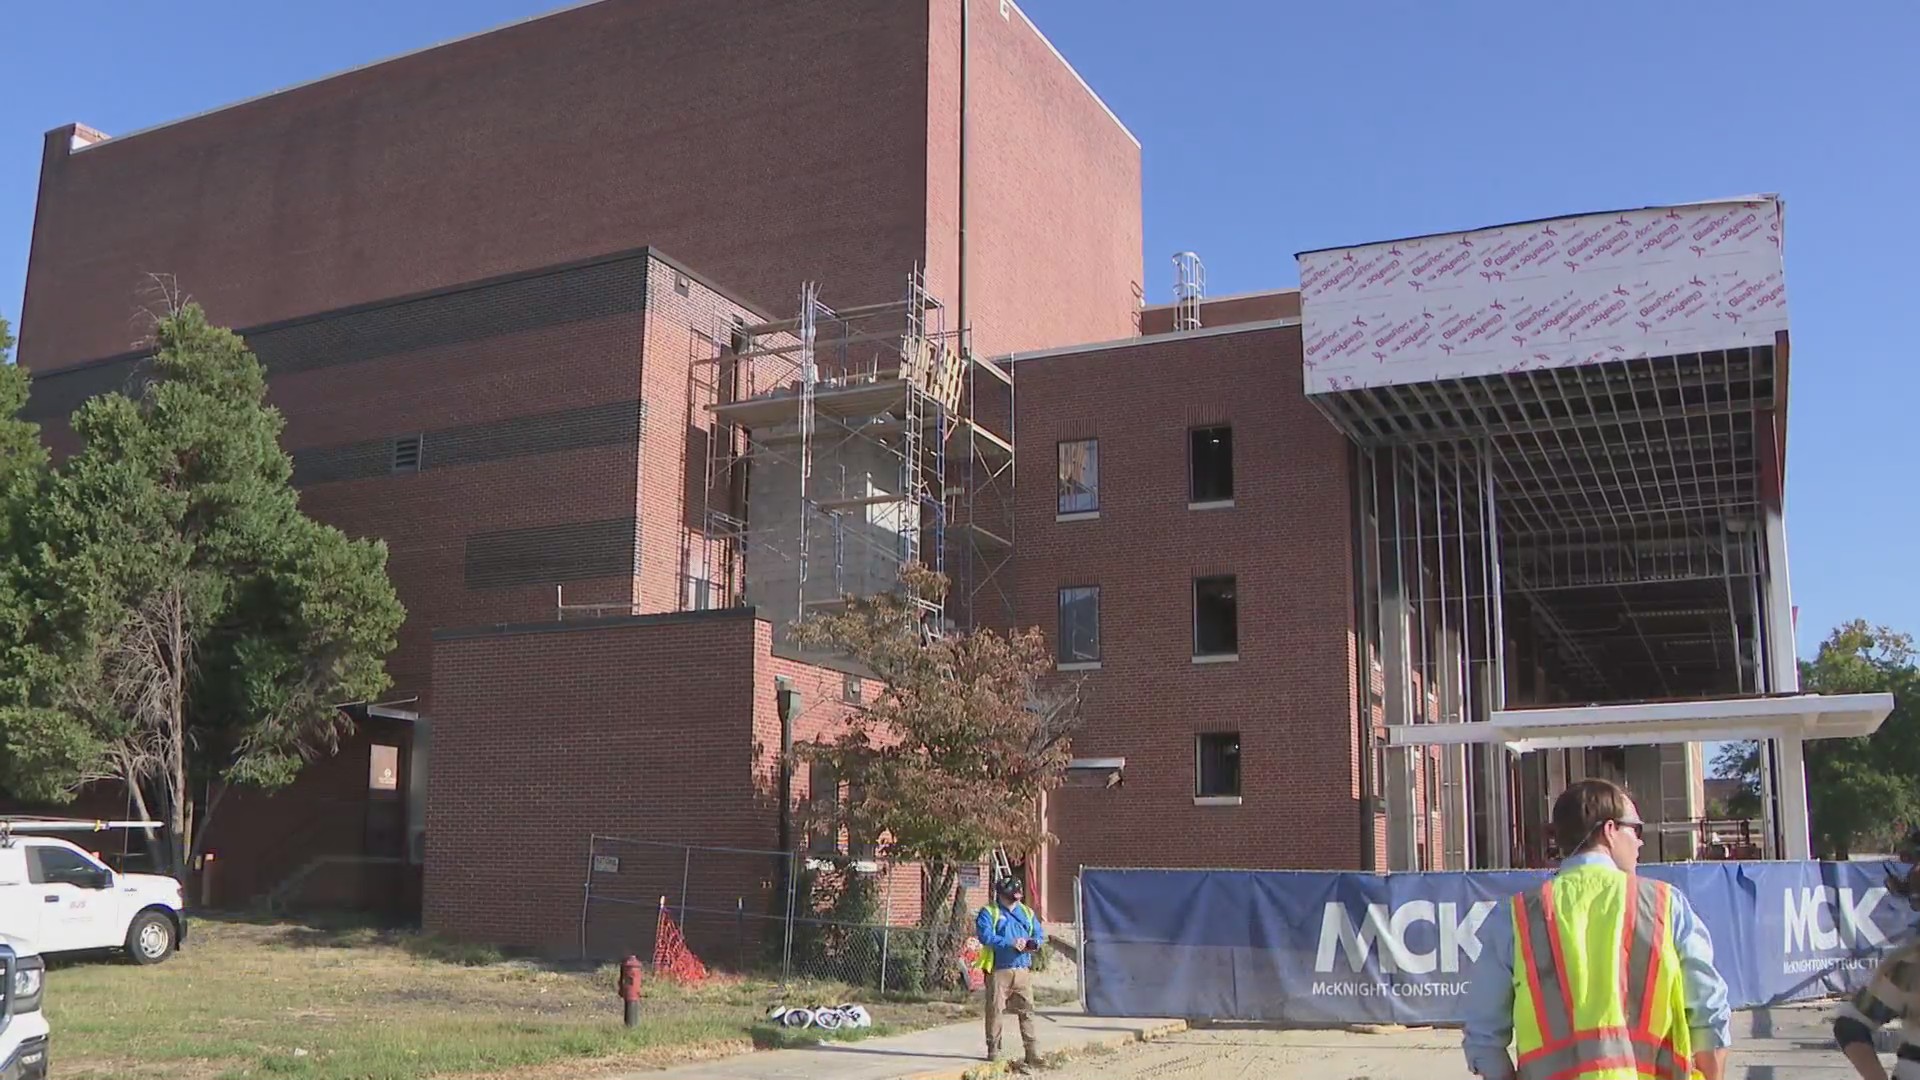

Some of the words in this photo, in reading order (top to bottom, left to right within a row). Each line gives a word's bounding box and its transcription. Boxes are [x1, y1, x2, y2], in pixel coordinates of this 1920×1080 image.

[1314, 900, 1497, 974] MCK
[1784, 885, 1889, 954] MCK
[1312, 981, 1389, 996] McKNIGHT
[1391, 980, 1473, 997] CONSTRUC
